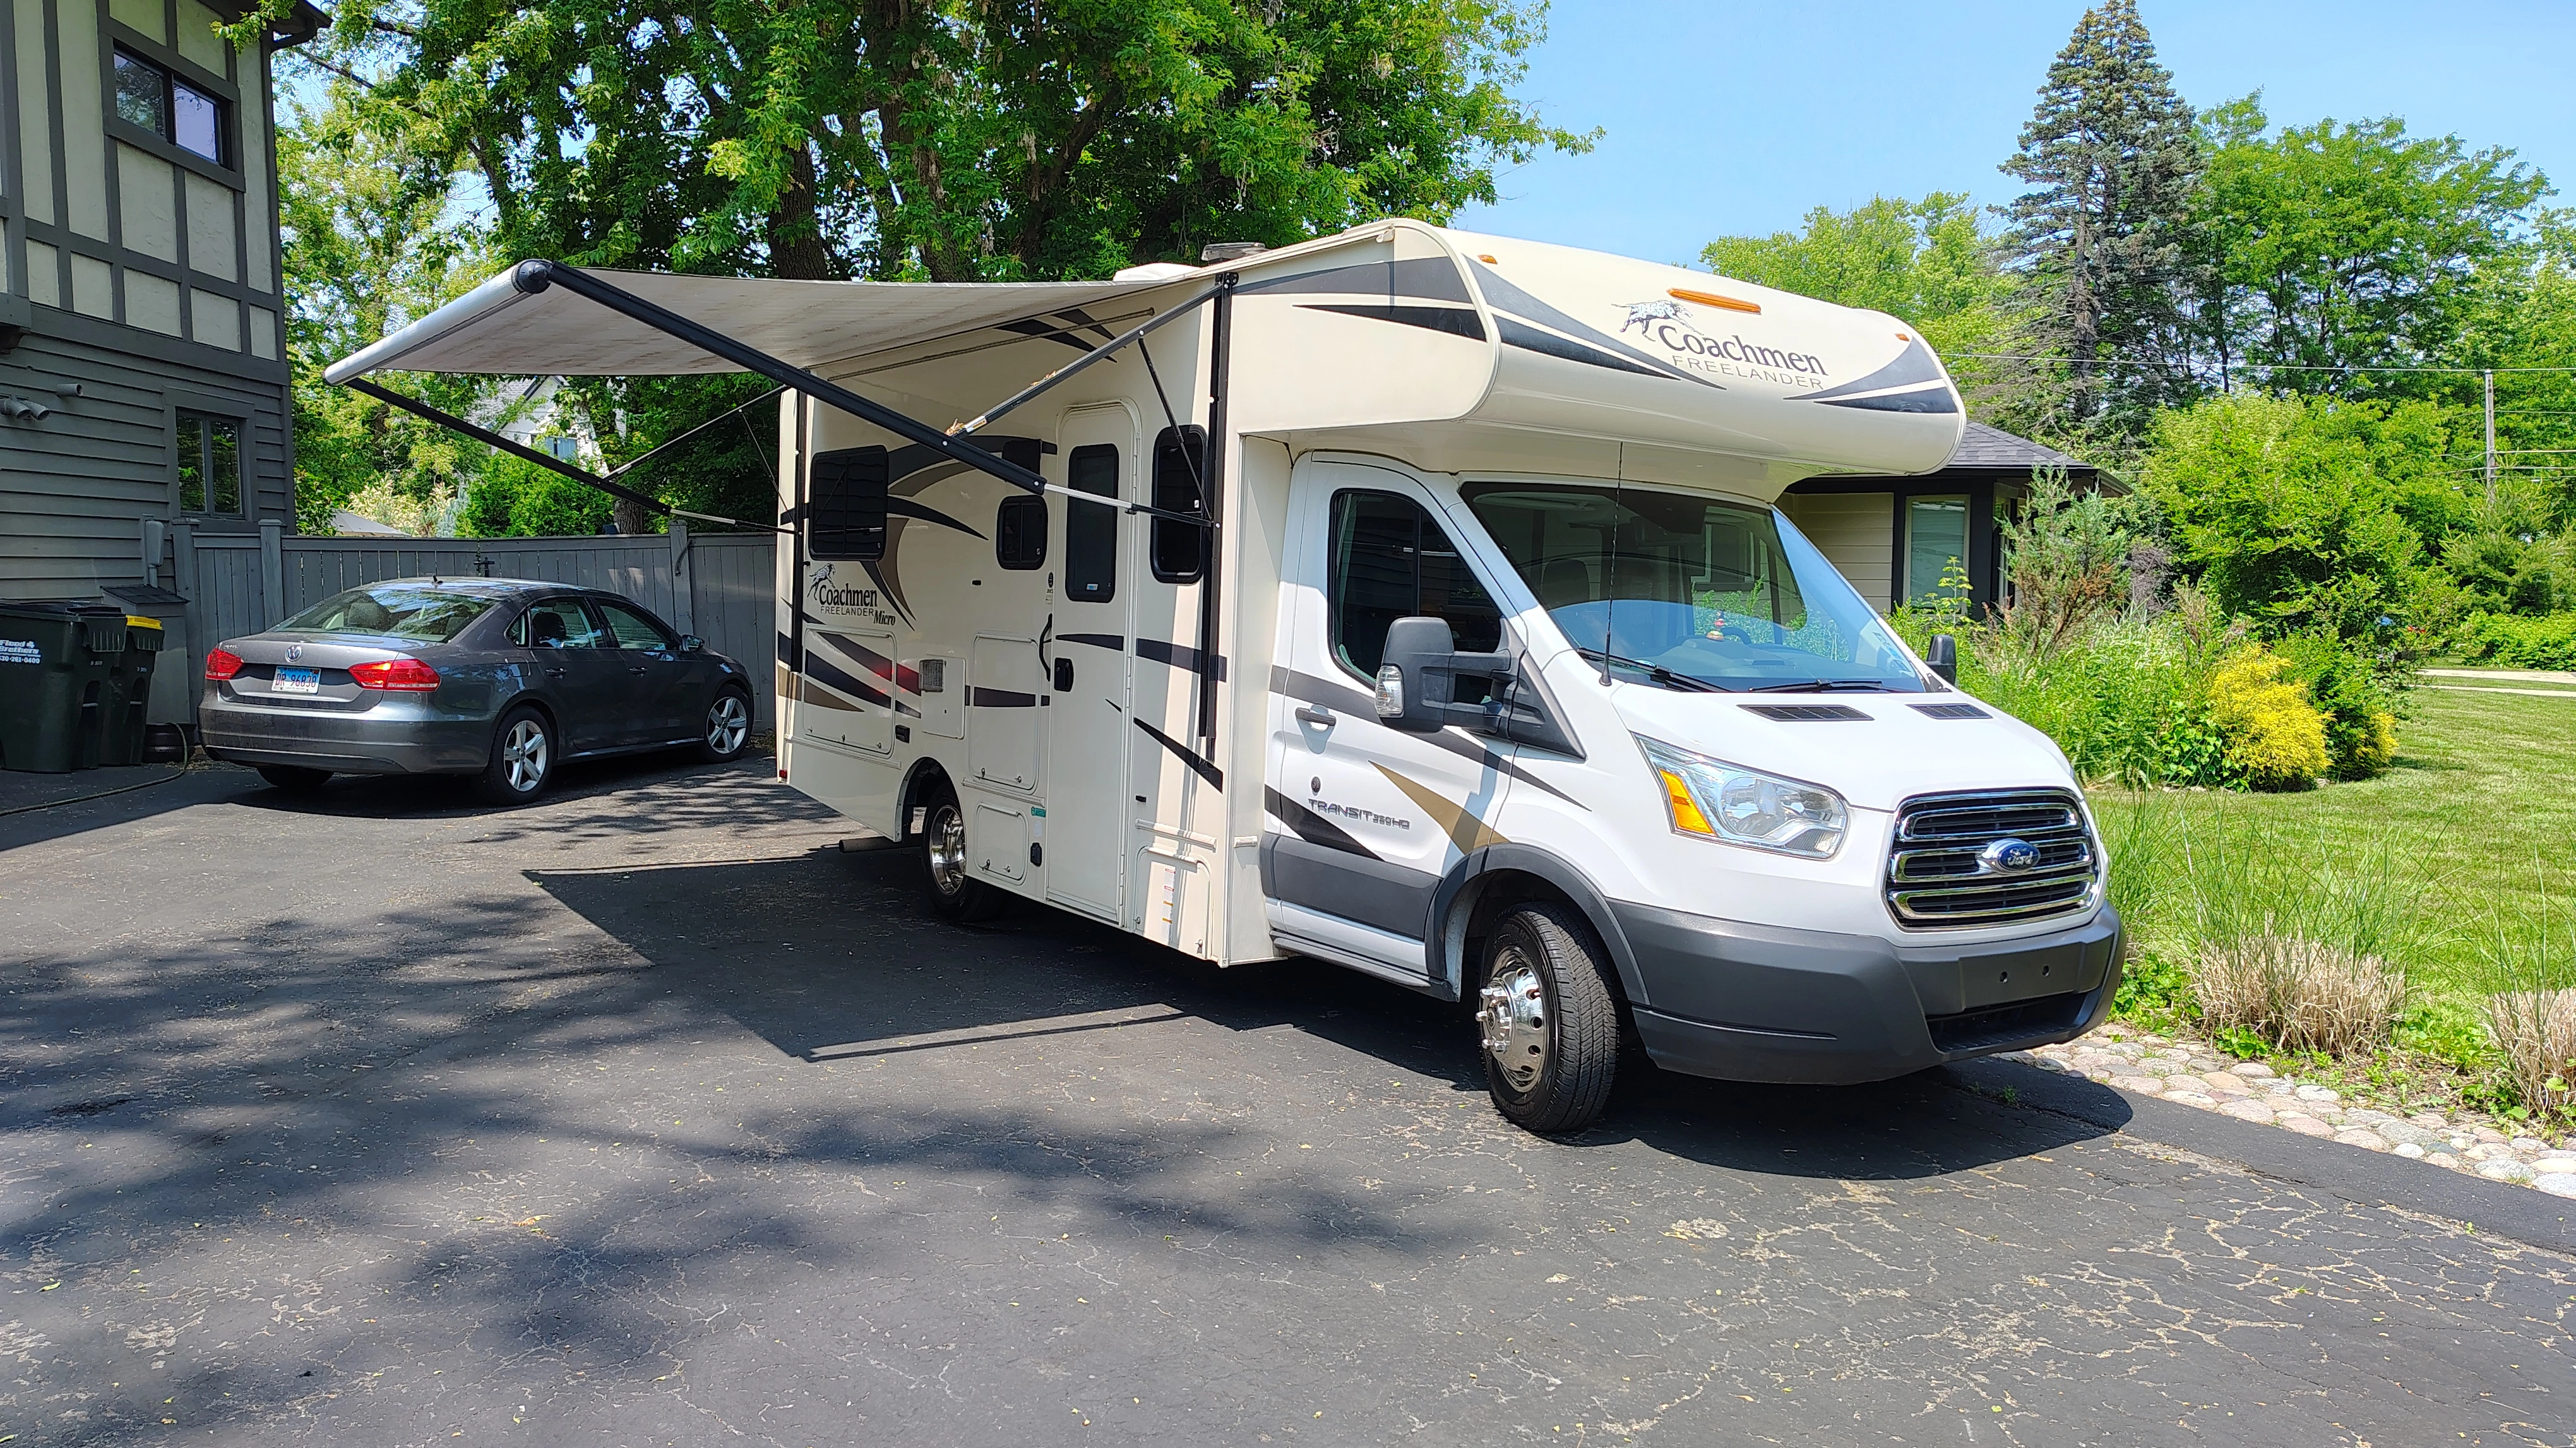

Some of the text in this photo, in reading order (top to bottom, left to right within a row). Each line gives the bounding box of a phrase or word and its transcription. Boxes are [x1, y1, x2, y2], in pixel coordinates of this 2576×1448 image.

[1658, 325, 1828, 376] Coachmen
[1671, 355, 1824, 390] FREELANDER
[819, 583, 878, 607] Coachmen
[820, 606, 874, 617] FREELANDER
[873, 610, 896, 626] Micro
[1308, 798, 1373, 822] TRANSIT
[2007, 848, 2034, 866] Ford
